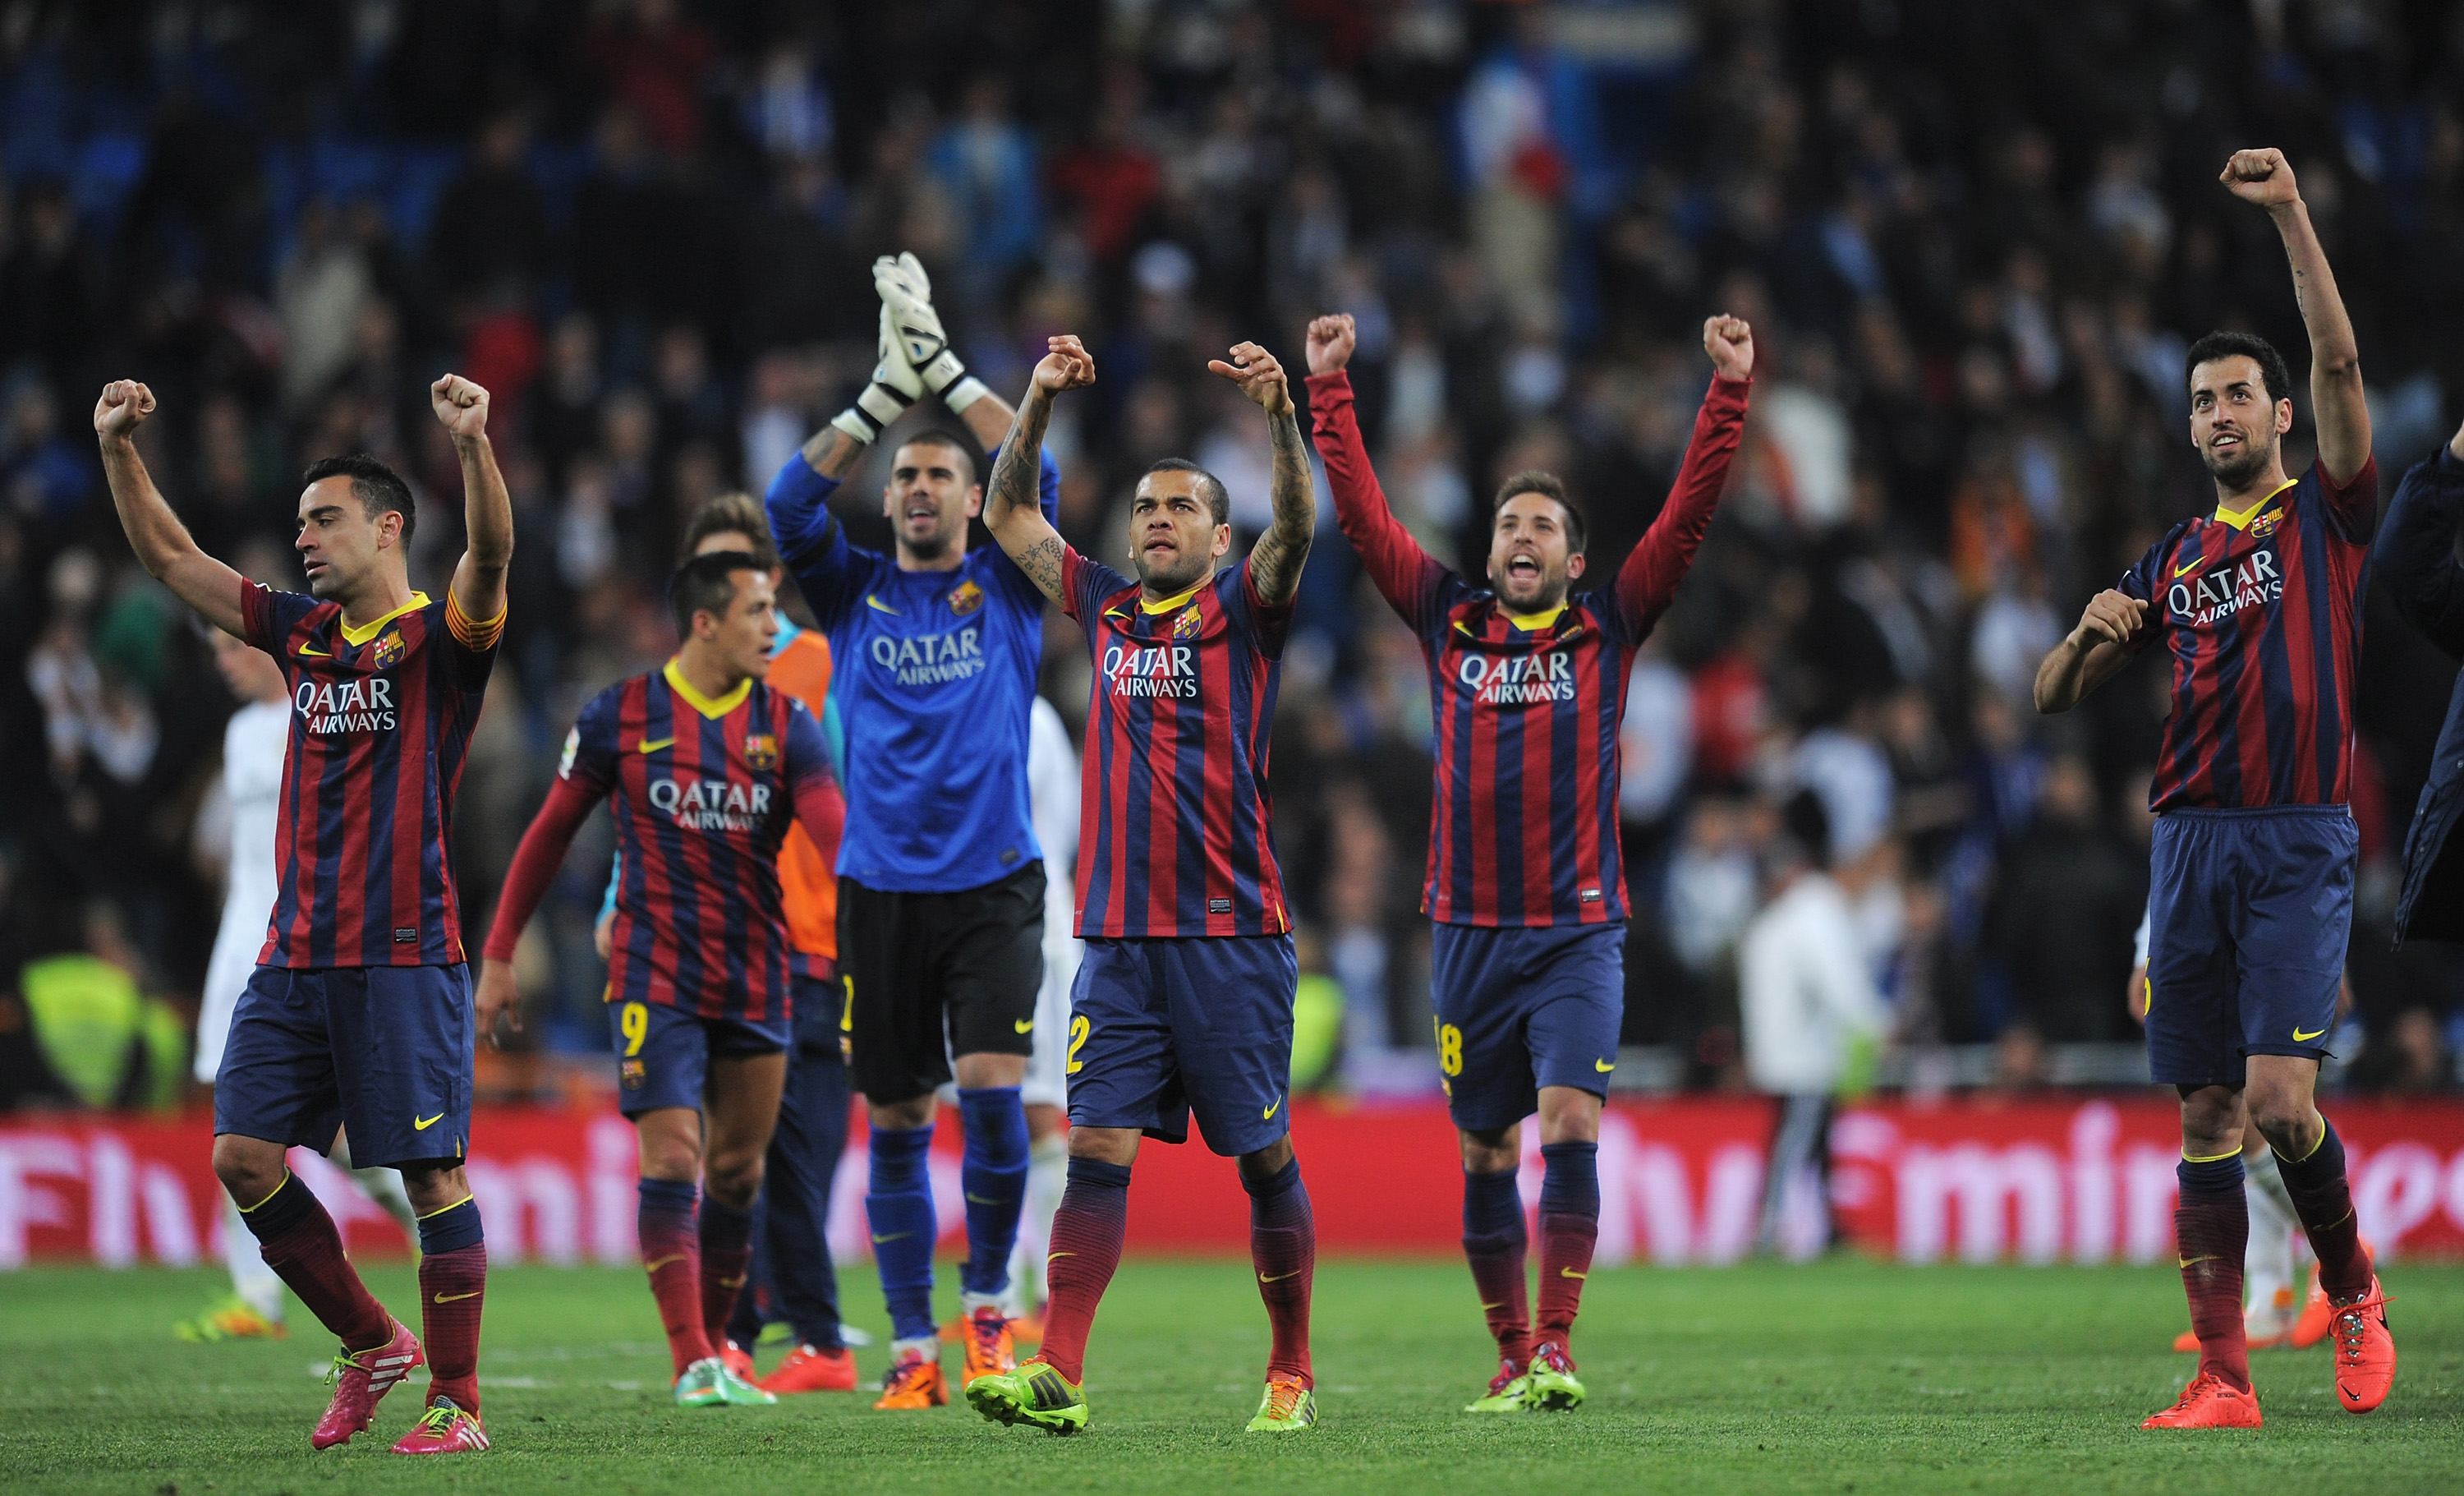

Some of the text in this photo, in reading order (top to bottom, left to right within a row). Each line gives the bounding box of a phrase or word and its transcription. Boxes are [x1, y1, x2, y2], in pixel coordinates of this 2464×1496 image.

[2168, 550, 2279, 619] QATAR
[2194, 580, 2282, 627] AIRWAYS
[871, 627, 982, 673] QATAR
[1103, 646, 1195, 682] QATAR
[896, 657, 986, 685] AIRWAYS
[1115, 677, 1197, 697] AIRWAYS
[1460, 651, 1571, 691] QATAR
[296, 679, 394, 719] QATAR
[1478, 680, 1574, 703] AIRWAYS
[309, 711, 396, 734] AIRWAYS
[648, 779, 771, 815] QATAR
[679, 808, 764, 831] AIRWA
[622, 1001, 648, 1057] 9
[1066, 1015, 1090, 1075] 2
